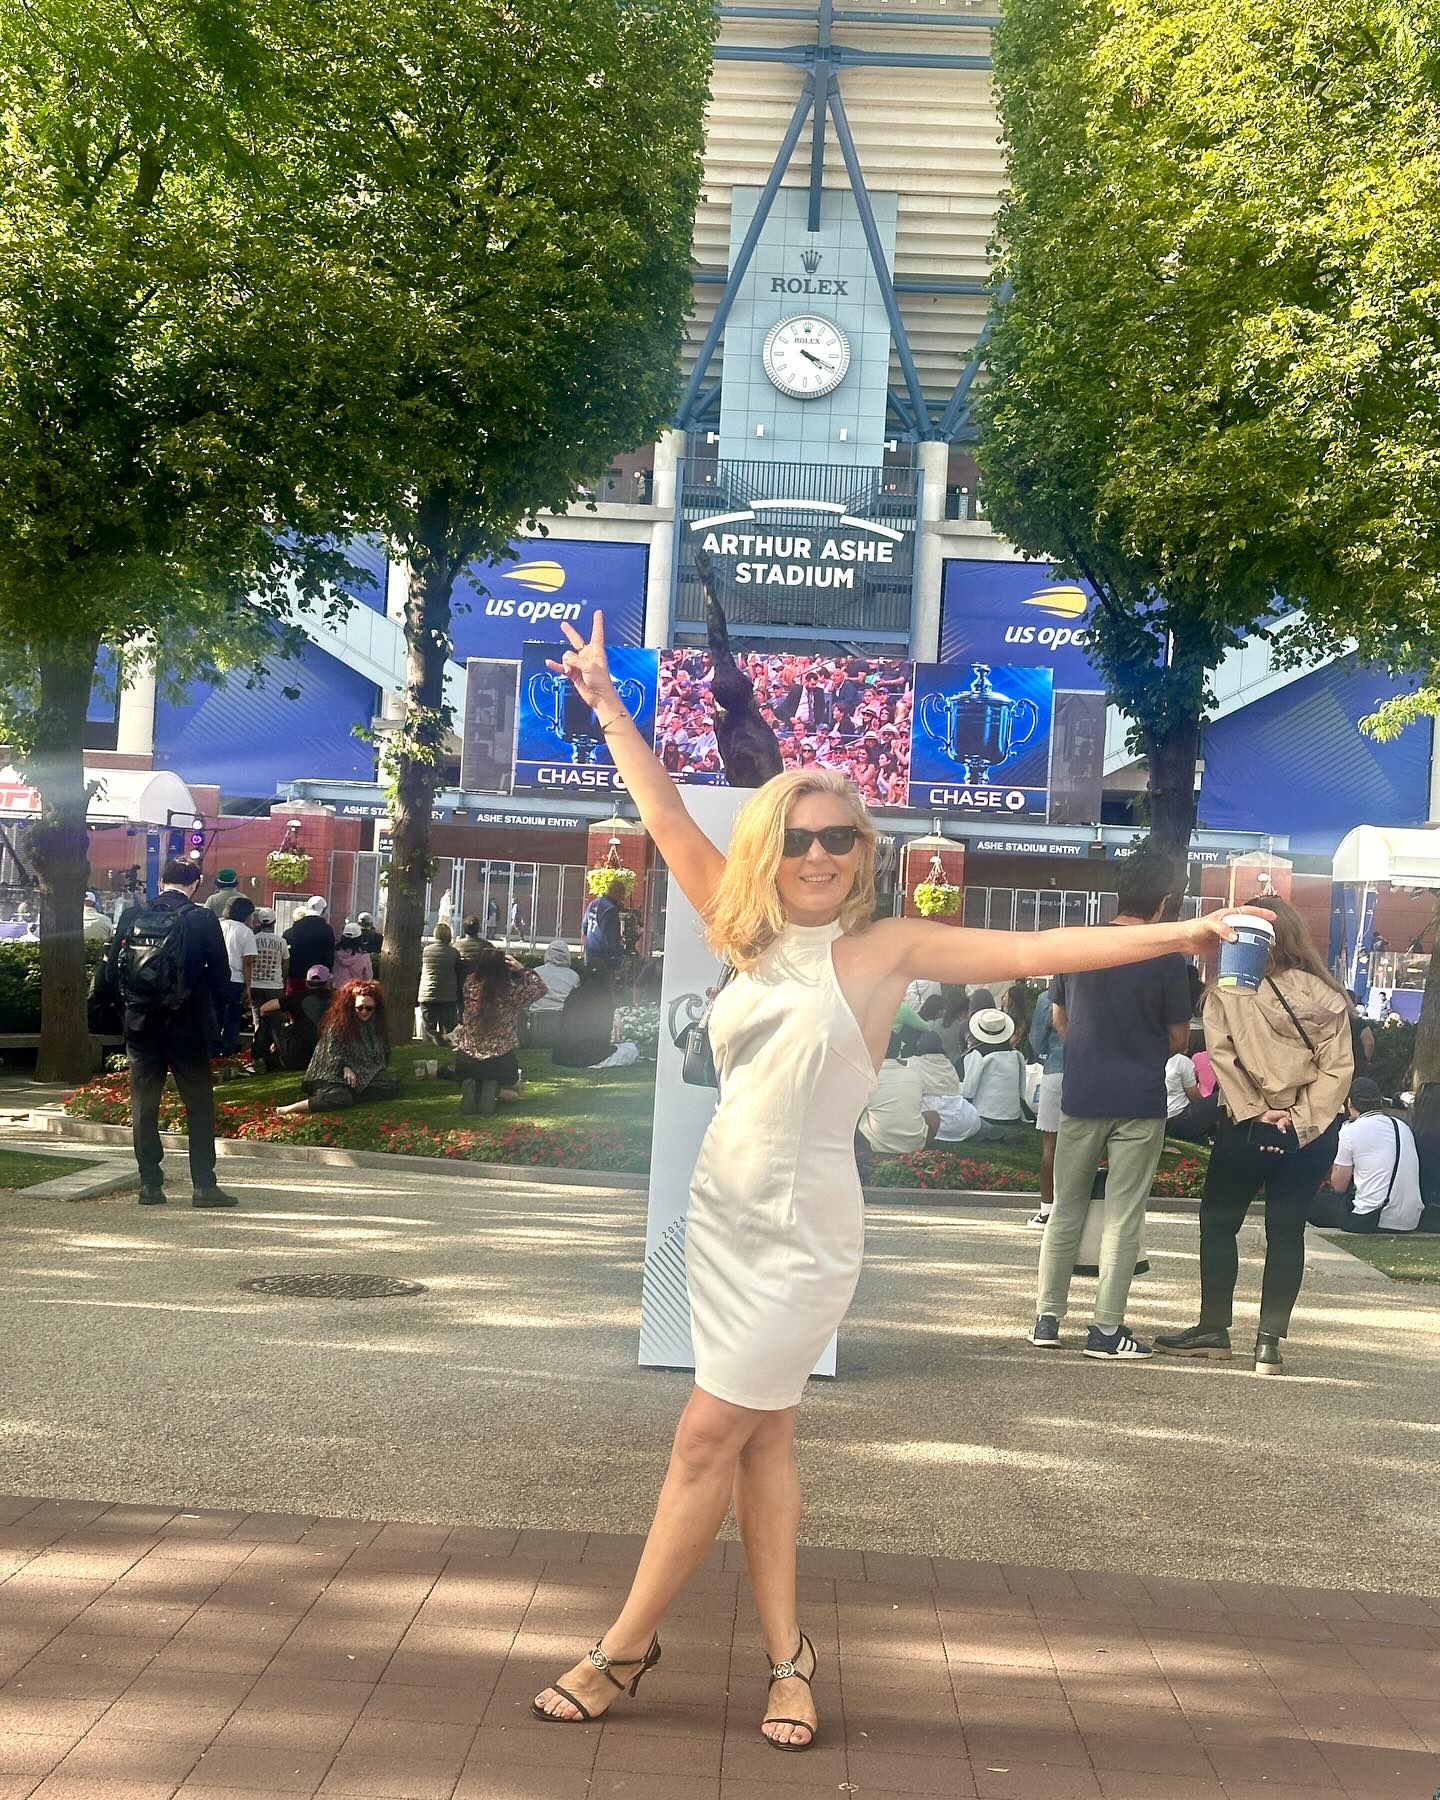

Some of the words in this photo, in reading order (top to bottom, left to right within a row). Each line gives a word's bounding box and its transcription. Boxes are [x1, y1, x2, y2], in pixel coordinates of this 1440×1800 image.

[770, 277, 849, 296] ROLEX
[794, 337, 821, 345] ROLEX
[702, 532, 812, 559] ARTHUR
[820, 538, 894, 563] ASHE
[735, 562, 855, 589] STADIUM
[485, 599, 517, 617] us
[517, 600, 582, 624] open
[1004, 625, 1036, 644] us
[537, 767, 609, 787] CHASE
[929, 788, 1003, 808] CHASE
[343, 805, 369, 815] ASHE
[477, 813, 503, 823] ASHE
[504, 815, 546, 826] STADIUM
[547, 818, 579, 827] ENTRY
[977, 841, 1004, 850] ASHE
[1005, 842, 1047, 853] STADIUM
[1049, 845, 1081, 854] ENTRY
[1113, 847, 1137, 857] ASH
[1187, 851, 1219, 861] ENTRY
[661, 1215, 687, 1239] 2024
